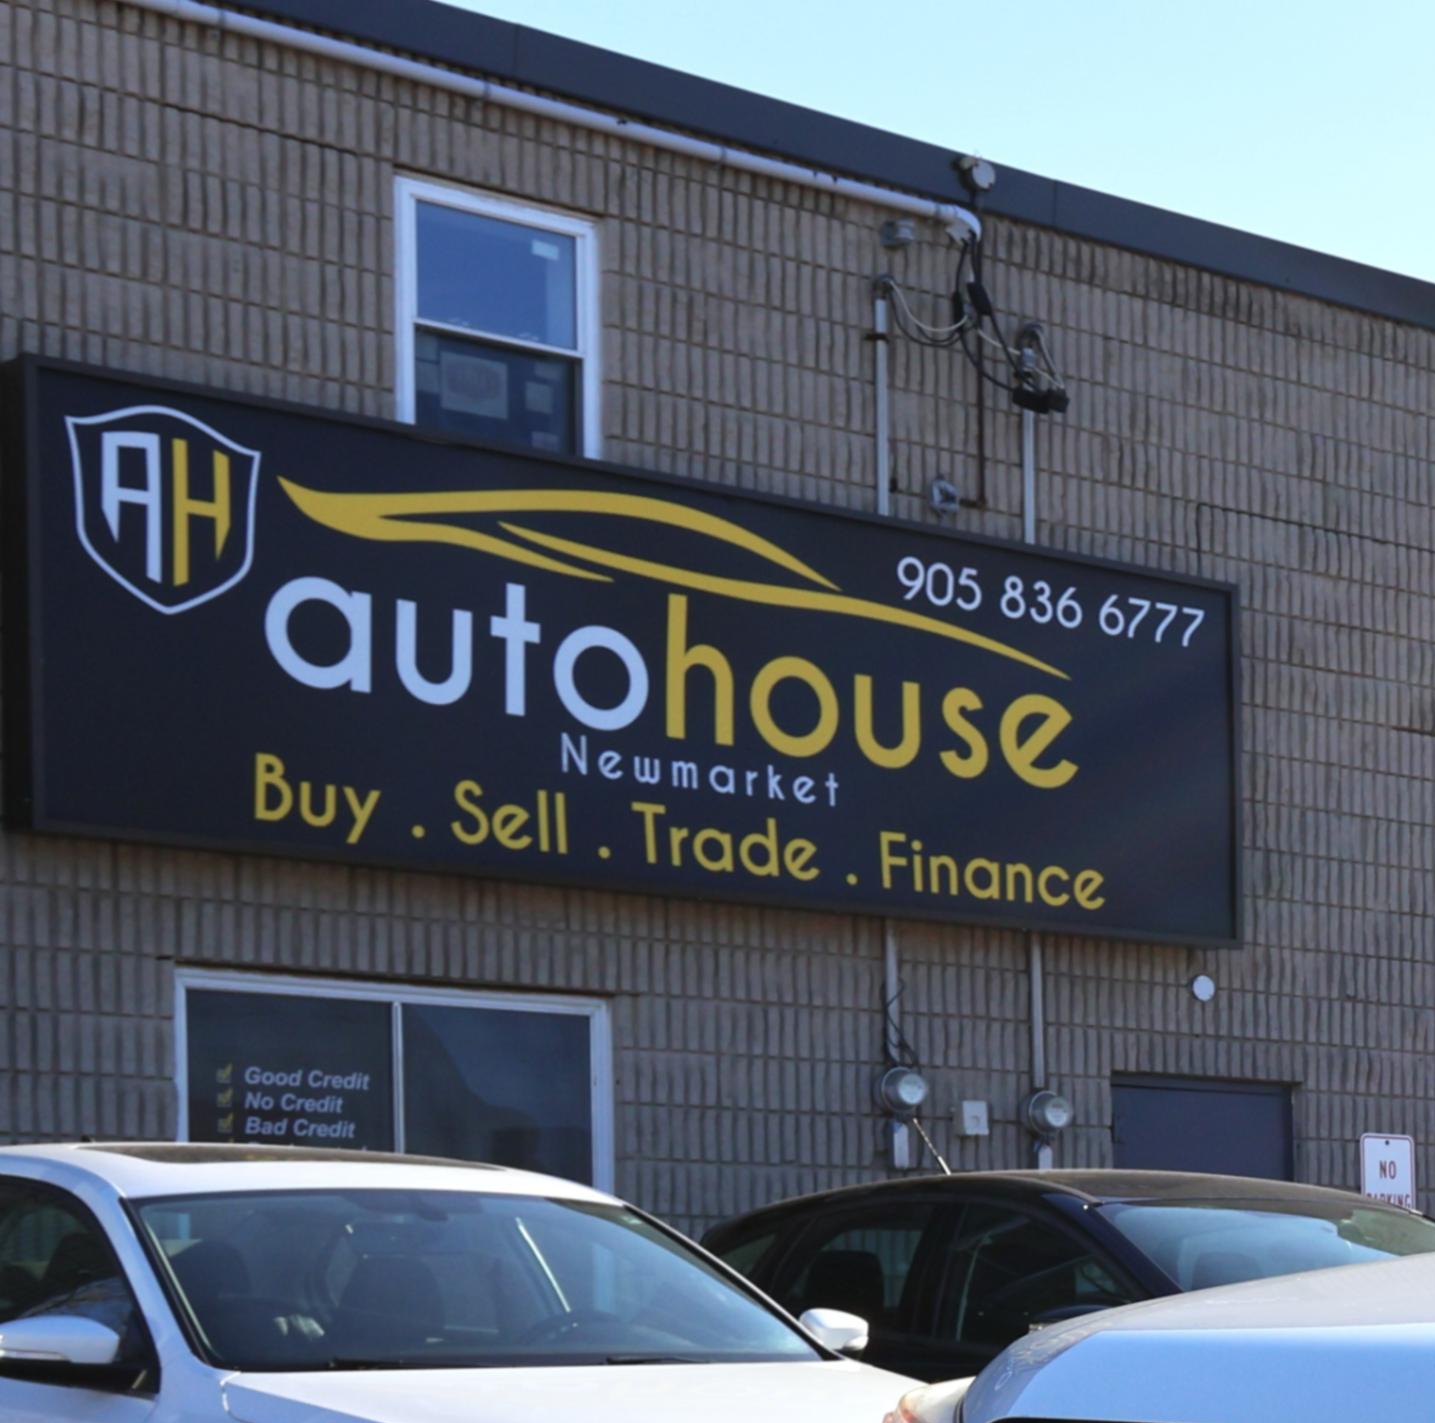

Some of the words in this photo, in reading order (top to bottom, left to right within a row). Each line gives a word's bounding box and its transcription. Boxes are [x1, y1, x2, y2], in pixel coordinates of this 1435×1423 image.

[896, 555, 982, 612] 905
[999, 580, 1083, 630] 836
[1098, 595, 1205, 648] 6777
[264, 575, 1080, 790] autohouse
[560, 732, 840, 806] Newmarket
[253, 752, 382, 844] Buy
[451, 781, 570, 856] Sell
[632, 801, 819, 884] Trade
[879, 832, 1107, 910] Finance
[244, 1066, 302, 1088] Good
[307, 1069, 371, 1091] Credit
[244, 1092, 274, 1110] No
[279, 1093, 344, 1114] Credit
[244, 1117, 288, 1136] Bad
[292, 1118, 356, 1139] Credit
[1379, 1160, 1397, 1180] NO
